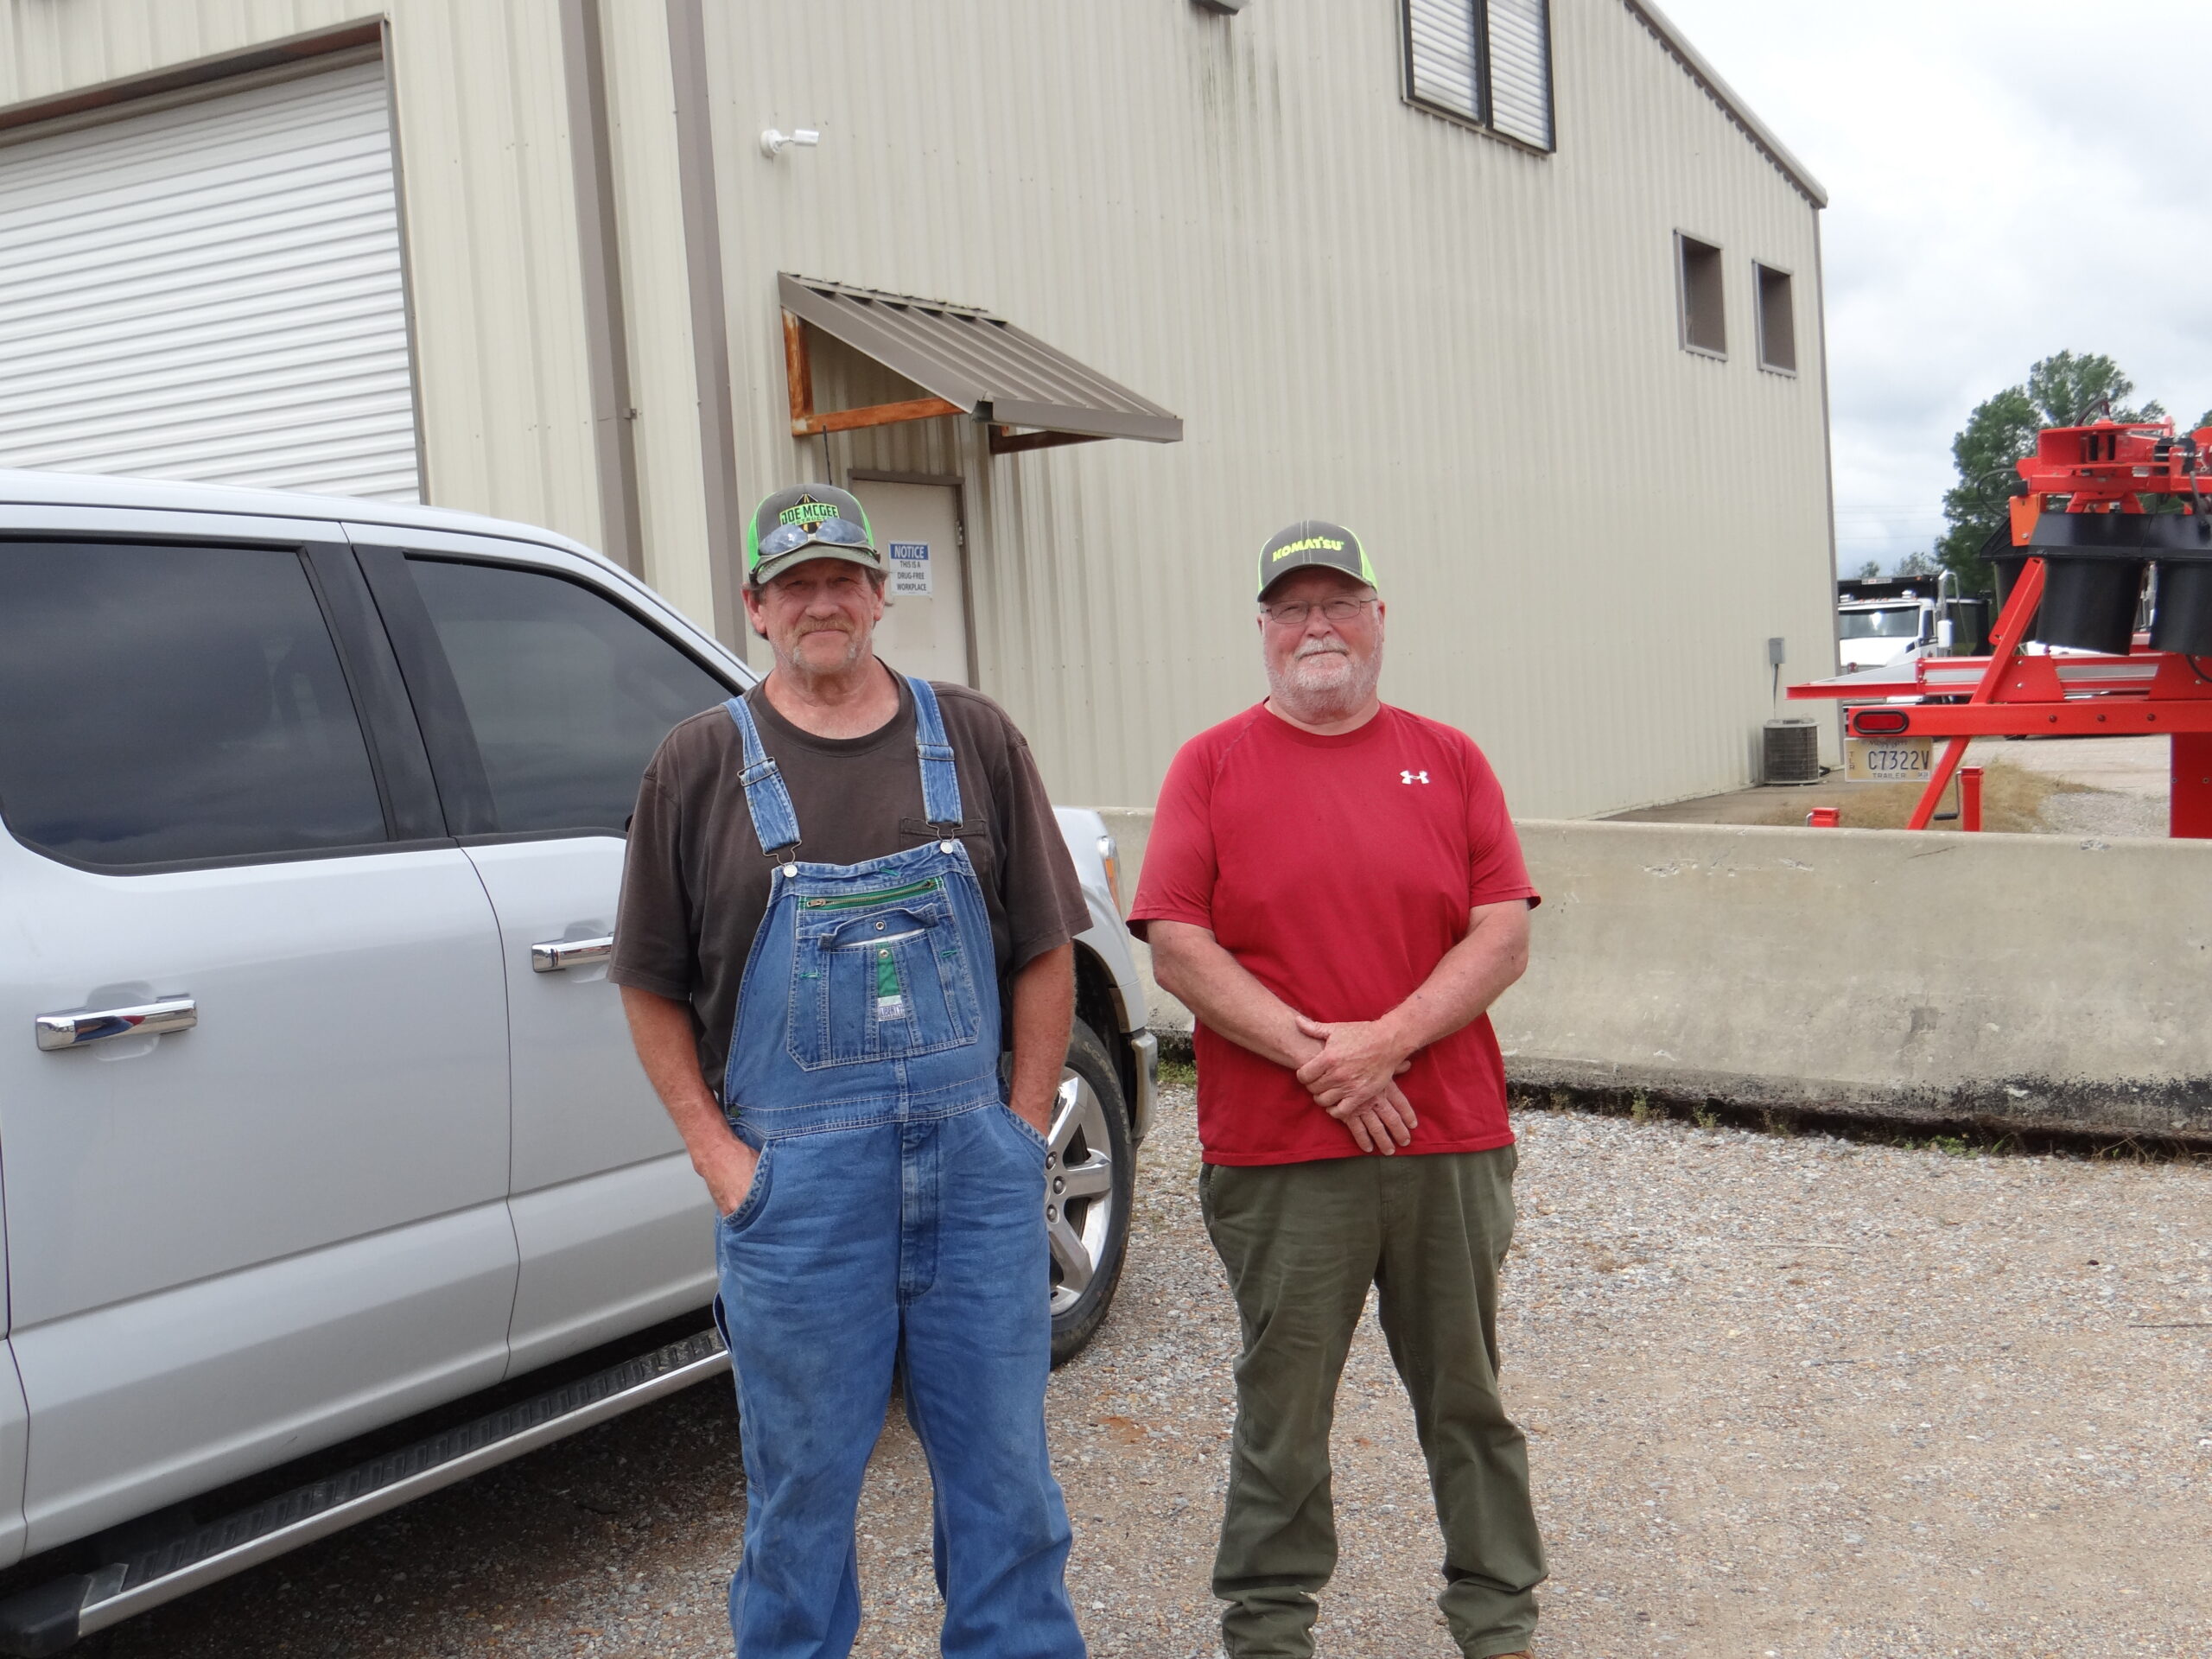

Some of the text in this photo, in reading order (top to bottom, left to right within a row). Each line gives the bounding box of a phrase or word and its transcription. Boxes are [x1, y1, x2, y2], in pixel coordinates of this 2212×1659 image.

[781, 505, 838, 525] JOE MCGEE
[894, 545, 925, 559] NOTICE
[1272, 536, 1342, 563] KOMATSU
[1868, 750, 1929, 771] C7322V
